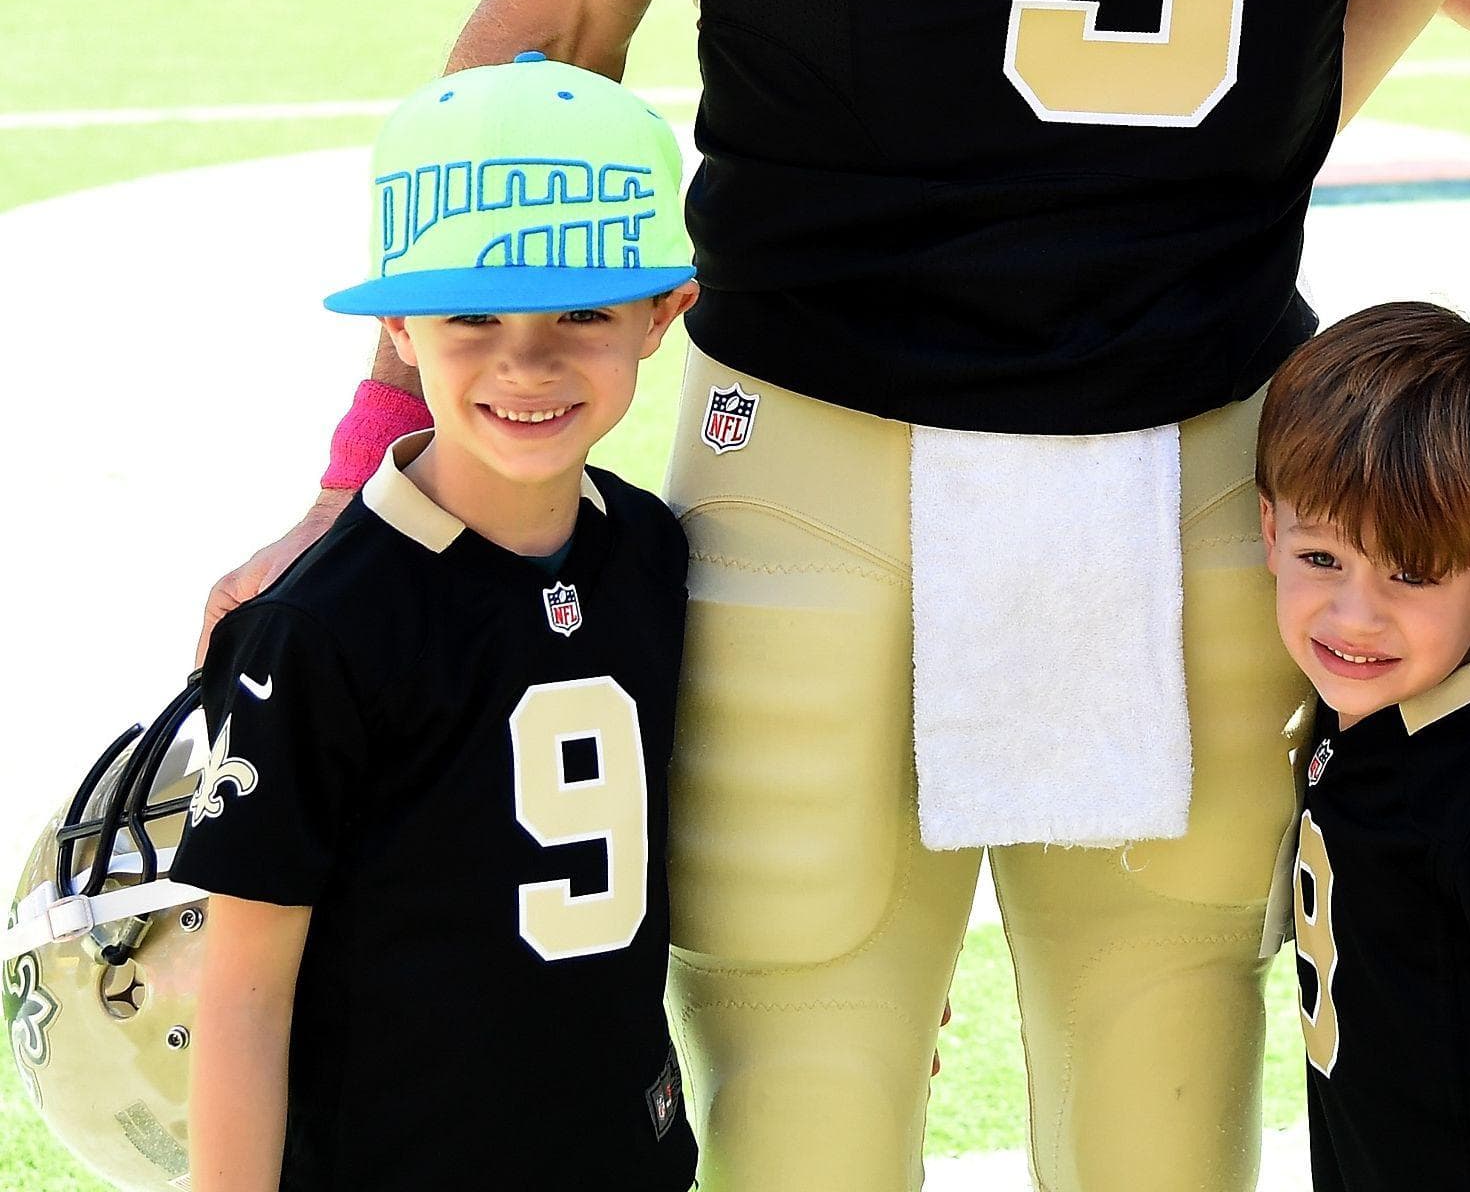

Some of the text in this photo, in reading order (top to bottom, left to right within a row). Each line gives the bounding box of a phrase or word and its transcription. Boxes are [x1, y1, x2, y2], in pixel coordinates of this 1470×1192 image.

[708, 412, 743, 443] NFL
[553, 604, 578, 626] NFL
[509, 675, 648, 961] 9
